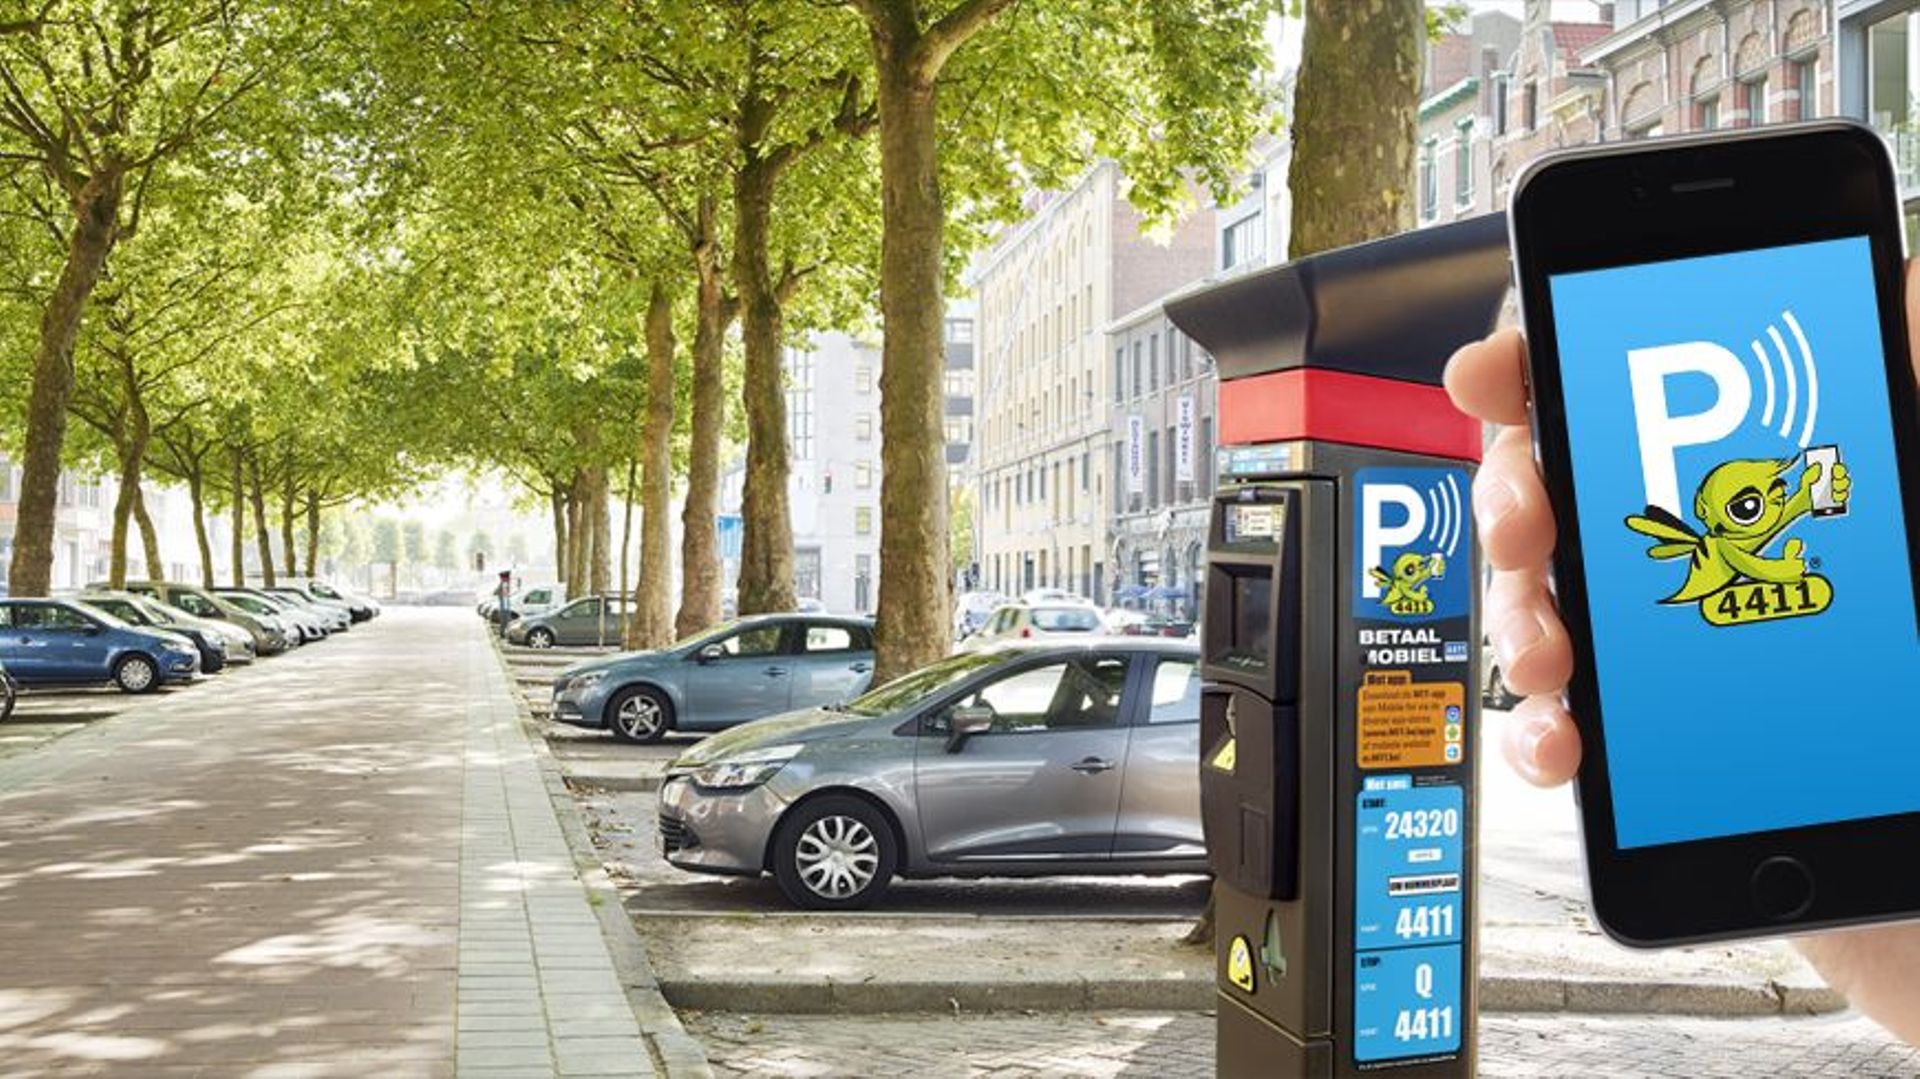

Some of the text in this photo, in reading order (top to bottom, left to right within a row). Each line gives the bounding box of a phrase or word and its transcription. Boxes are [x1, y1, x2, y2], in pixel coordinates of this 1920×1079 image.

[1627, 340, 1751, 519] P
[1362, 484, 1427, 598] P
[1395, 601, 1429, 614] 4411
[1717, 582, 1818, 620] 4411
[1359, 629, 1441, 645] BETAAL
[1385, 808, 1457, 840] 24320
[1396, 905, 1453, 939] 4411
[1415, 963, 1433, 999] Q
[1394, 1005, 1453, 1042] 4411
